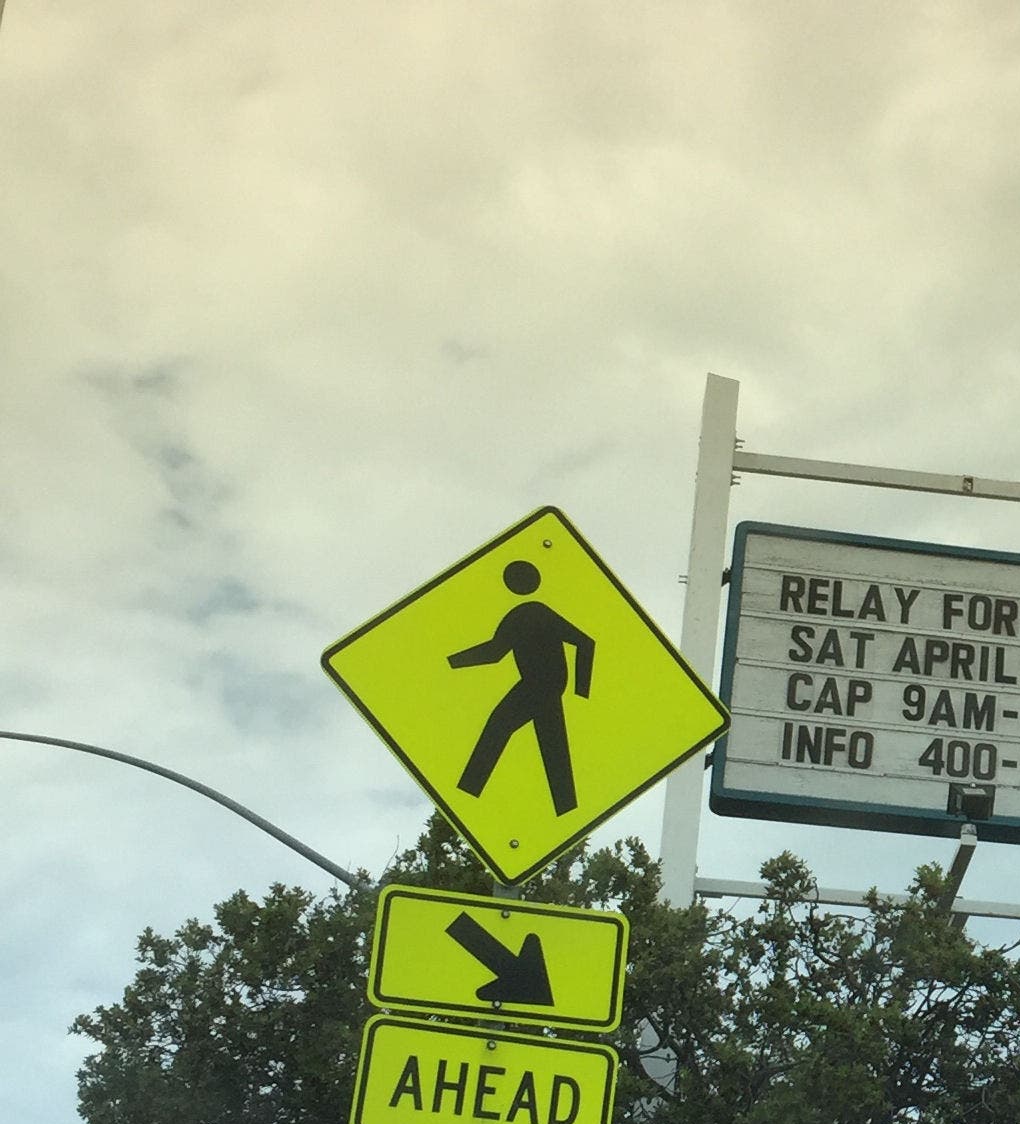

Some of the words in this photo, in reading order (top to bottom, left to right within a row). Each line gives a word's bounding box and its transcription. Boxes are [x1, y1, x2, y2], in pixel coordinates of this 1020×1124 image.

[779, 574, 921, 625] RELAY
[942, 594, 1018, 637] FOR
[788, 625, 875, 670] SAT
[892, 637, 1017, 685] APRIL
[786, 673, 873, 718] CAP
[781, 722, 874, 770] INFO
